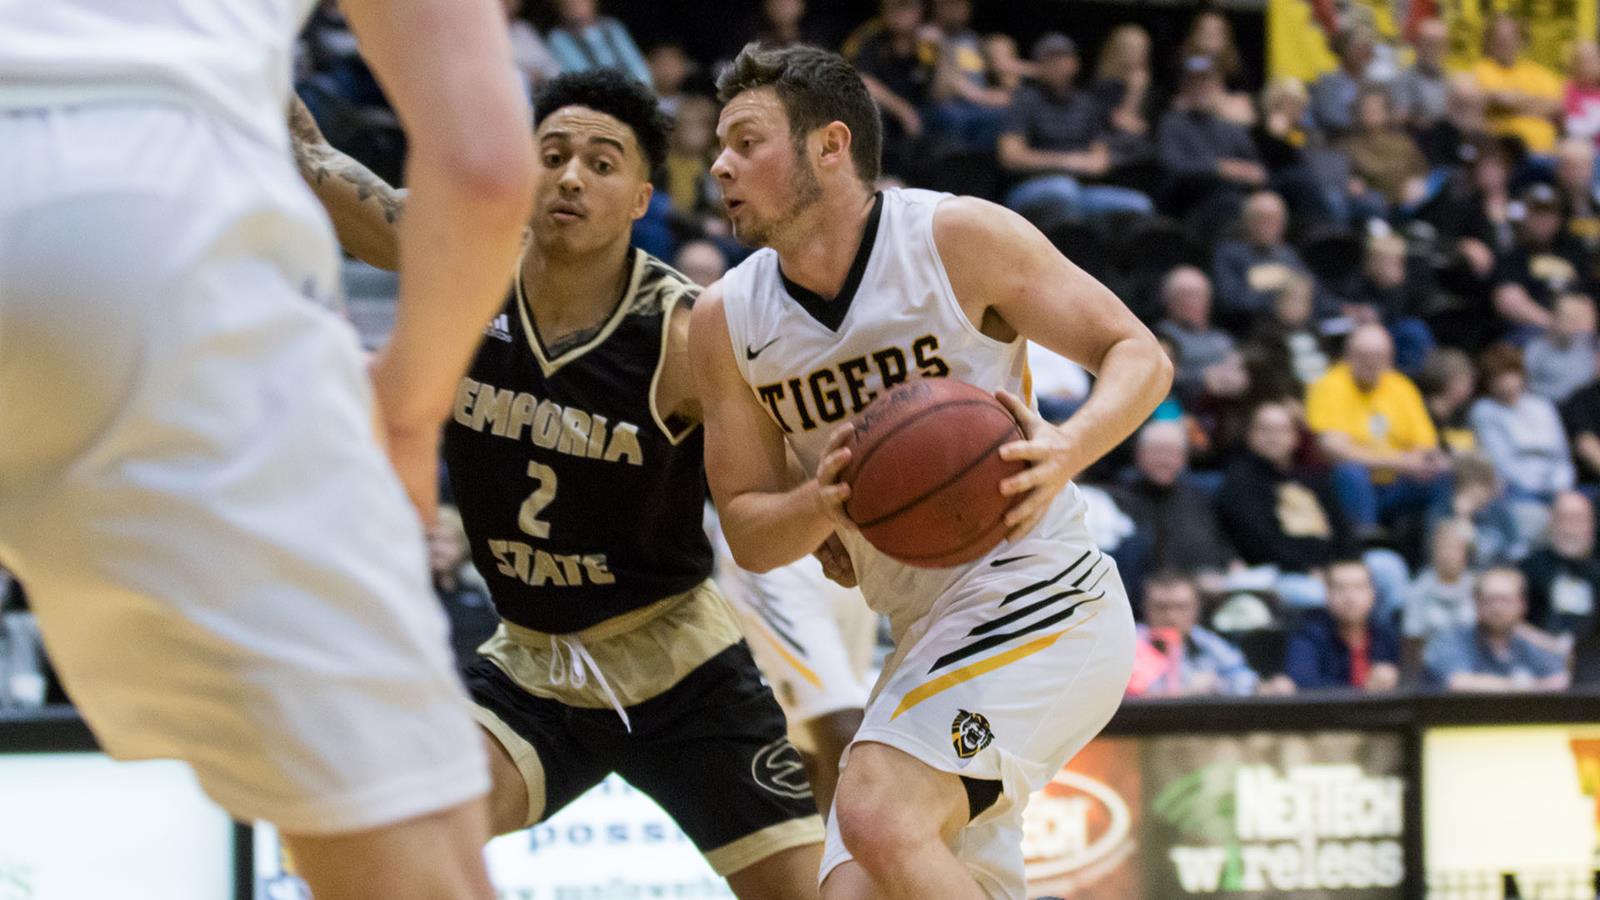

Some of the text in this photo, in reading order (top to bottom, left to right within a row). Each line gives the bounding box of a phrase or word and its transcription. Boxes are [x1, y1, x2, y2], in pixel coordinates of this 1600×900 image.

[453, 376, 643, 466] EMPORIA
[757, 333, 950, 433] TIGERS
[517, 459, 558, 540] 2
[487, 538, 616, 587] STATE
[1168, 841, 1405, 892] wireless
